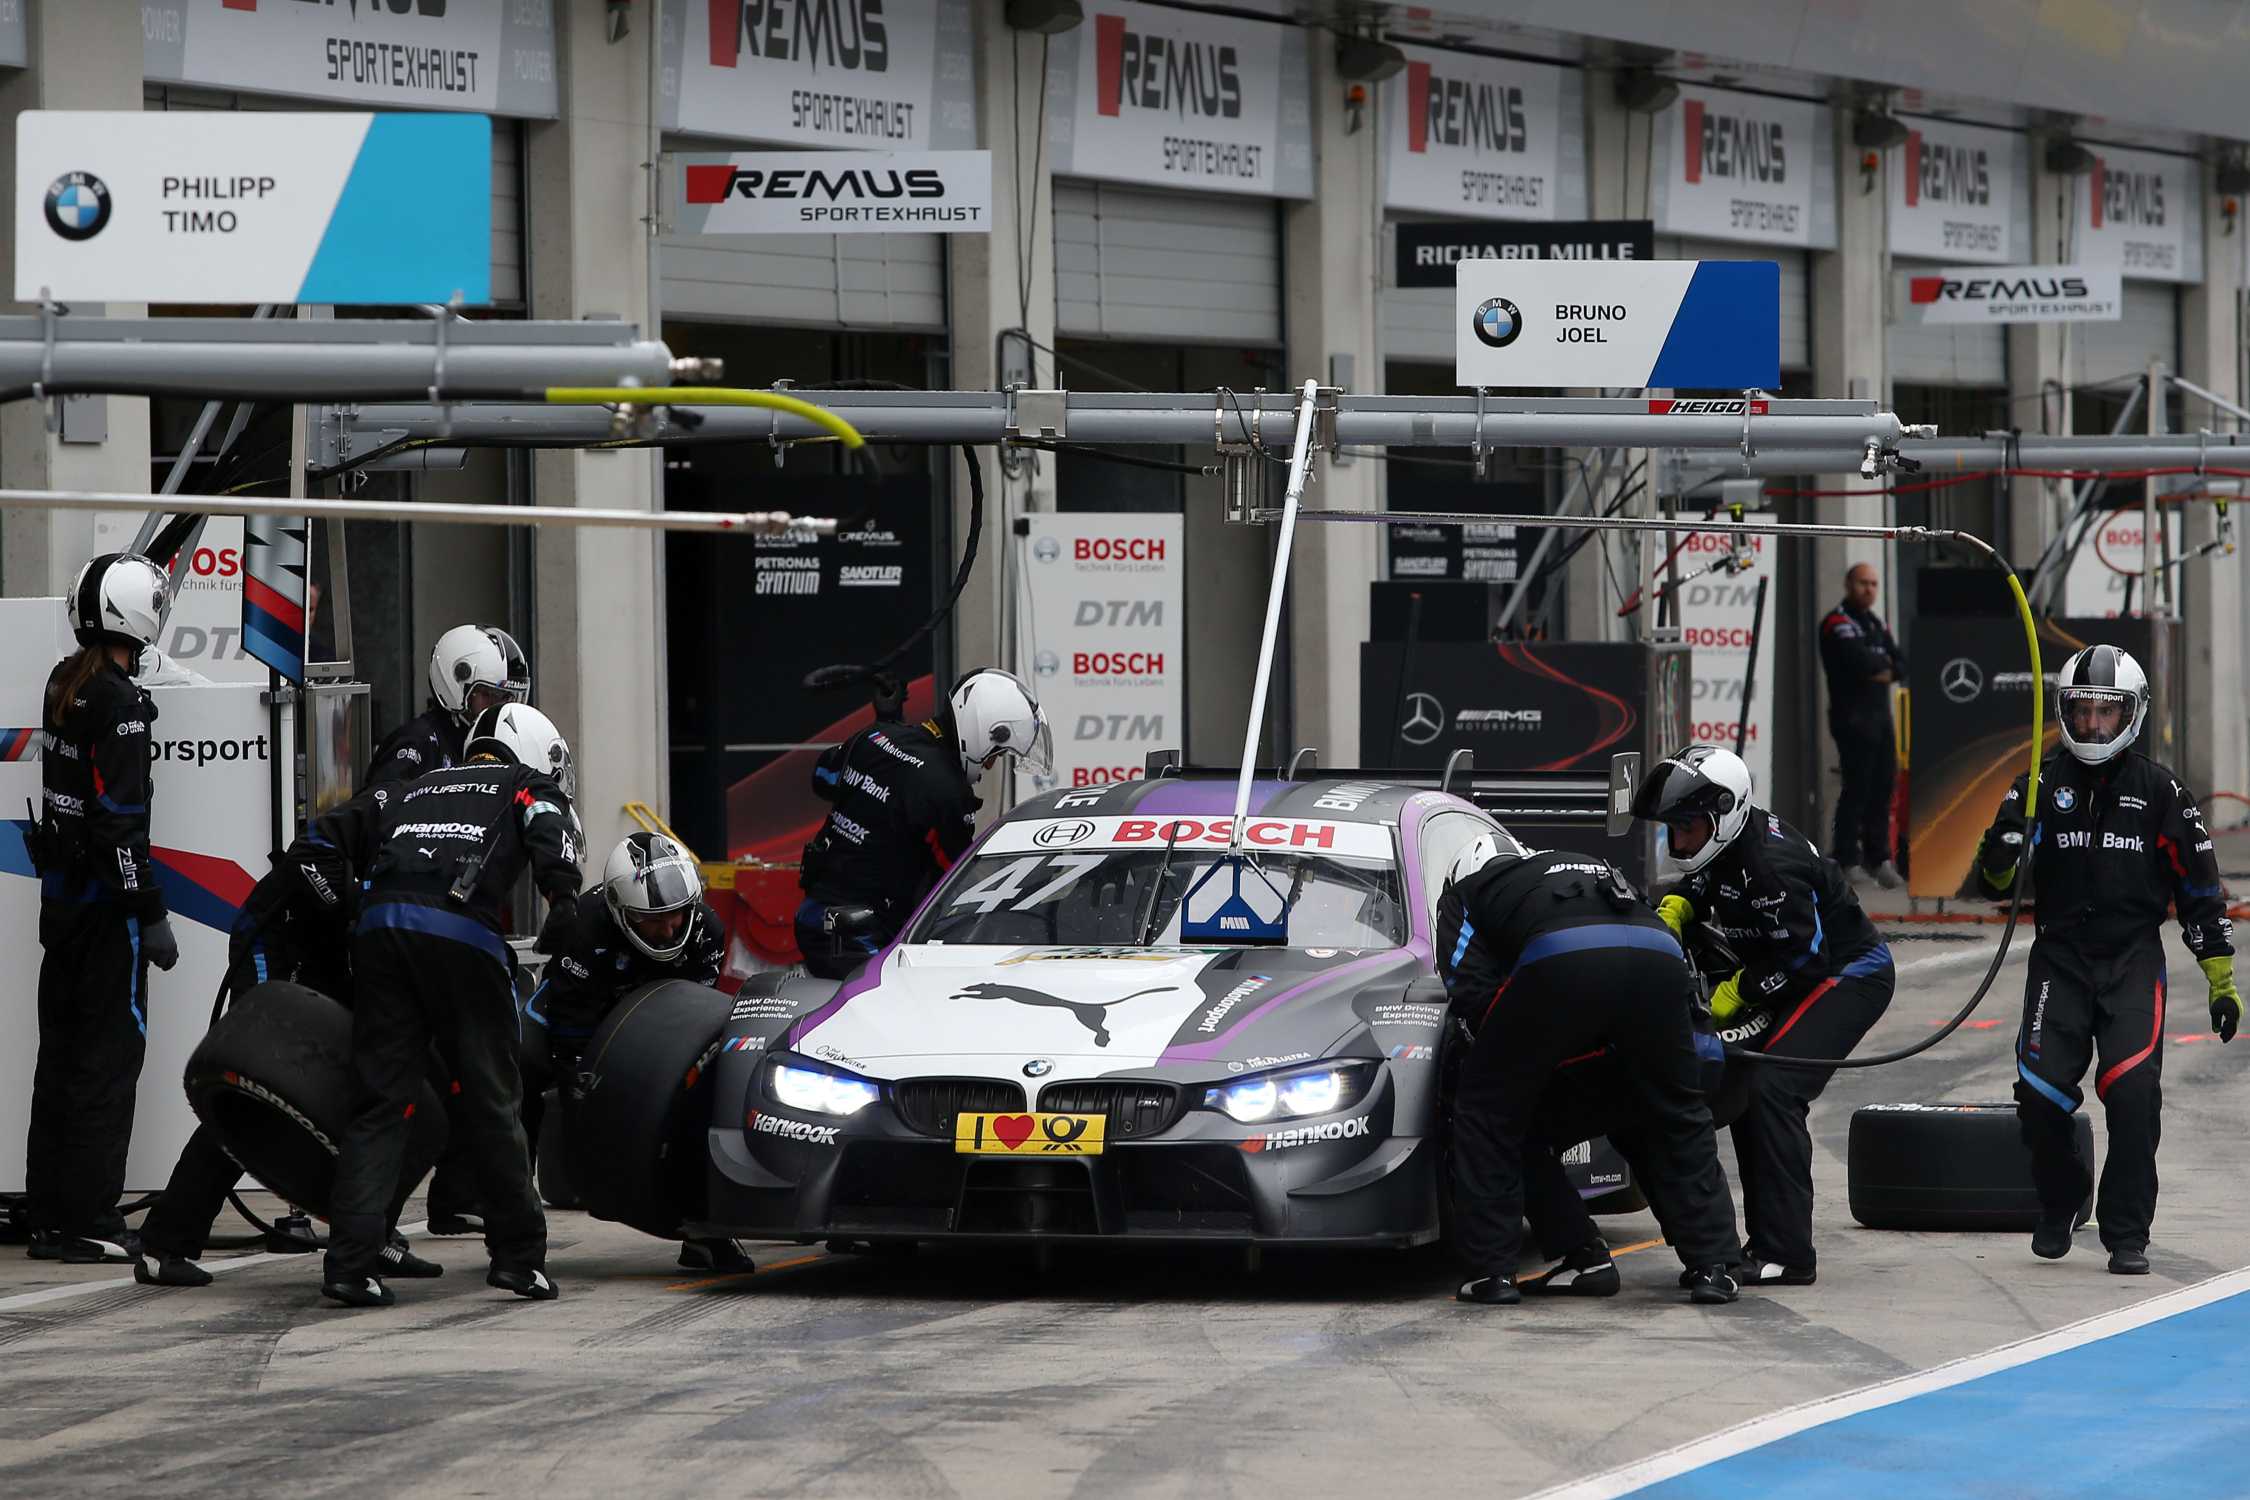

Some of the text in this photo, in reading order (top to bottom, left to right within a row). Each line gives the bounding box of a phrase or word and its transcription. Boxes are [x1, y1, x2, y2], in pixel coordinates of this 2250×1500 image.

[736, 0, 888, 74] REMUS
[327, 37, 478, 93] SPORTEXHAUST
[1119, 31, 1241, 121] REMUS
[792, 89, 914, 140] SPORTEXHAUST
[1426, 75, 1526, 156] REMUS
[1163, 136, 1262, 178] SPORTEXHAUST
[1703, 114, 1786, 186] REMUS
[723, 169, 945, 201] REMUS
[1918, 143, 1990, 207] REMUS
[162, 177, 275, 199] PHILIPP
[2103, 169, 2166, 227] REMUS
[162, 210, 238, 233] TIMO
[801, 206, 981, 222] SPORTEXHAUST
[1416, 242, 1635, 266] RICHARD MILLE
[1935, 276, 2089, 300] REMUS
[1555, 304, 1627, 321] BRUNO
[1556, 327, 1607, 343] JOEL
[1670, 400, 1747, 415] HEIGO
[1074, 538, 1165, 561] BOSCH
[1688, 533, 1761, 553] BOSH
[755, 556, 820, 569] PETRONAS
[183, 578, 217, 592] chnik
[1074, 600, 1164, 626] DTM
[168, 626, 249, 660] DT
[1073, 652, 1164, 674] BOSCH
[2080, 691, 2124, 702] Motorsport
[1485, 710, 1542, 721] AMG
[1074, 714, 1164, 741] DTM
[150, 734, 268, 767] orsport
[882, 741, 925, 768] Motorsport
[860, 773, 891, 803] Bank
[1073, 767, 1144, 787] BOSC
[432, 783, 500, 795] LIFESTYLE
[1111, 820, 1336, 849] BOSCH
[2102, 831, 2145, 853] Bank
[951, 854, 1108, 915] 47
[733, 1005, 787, 1014] Experience
[736, 998, 799, 1007] BMW Driving
[1375, 1004, 1441, 1015] BMW Driving
[1382, 1011, 1440, 1021] Experience
